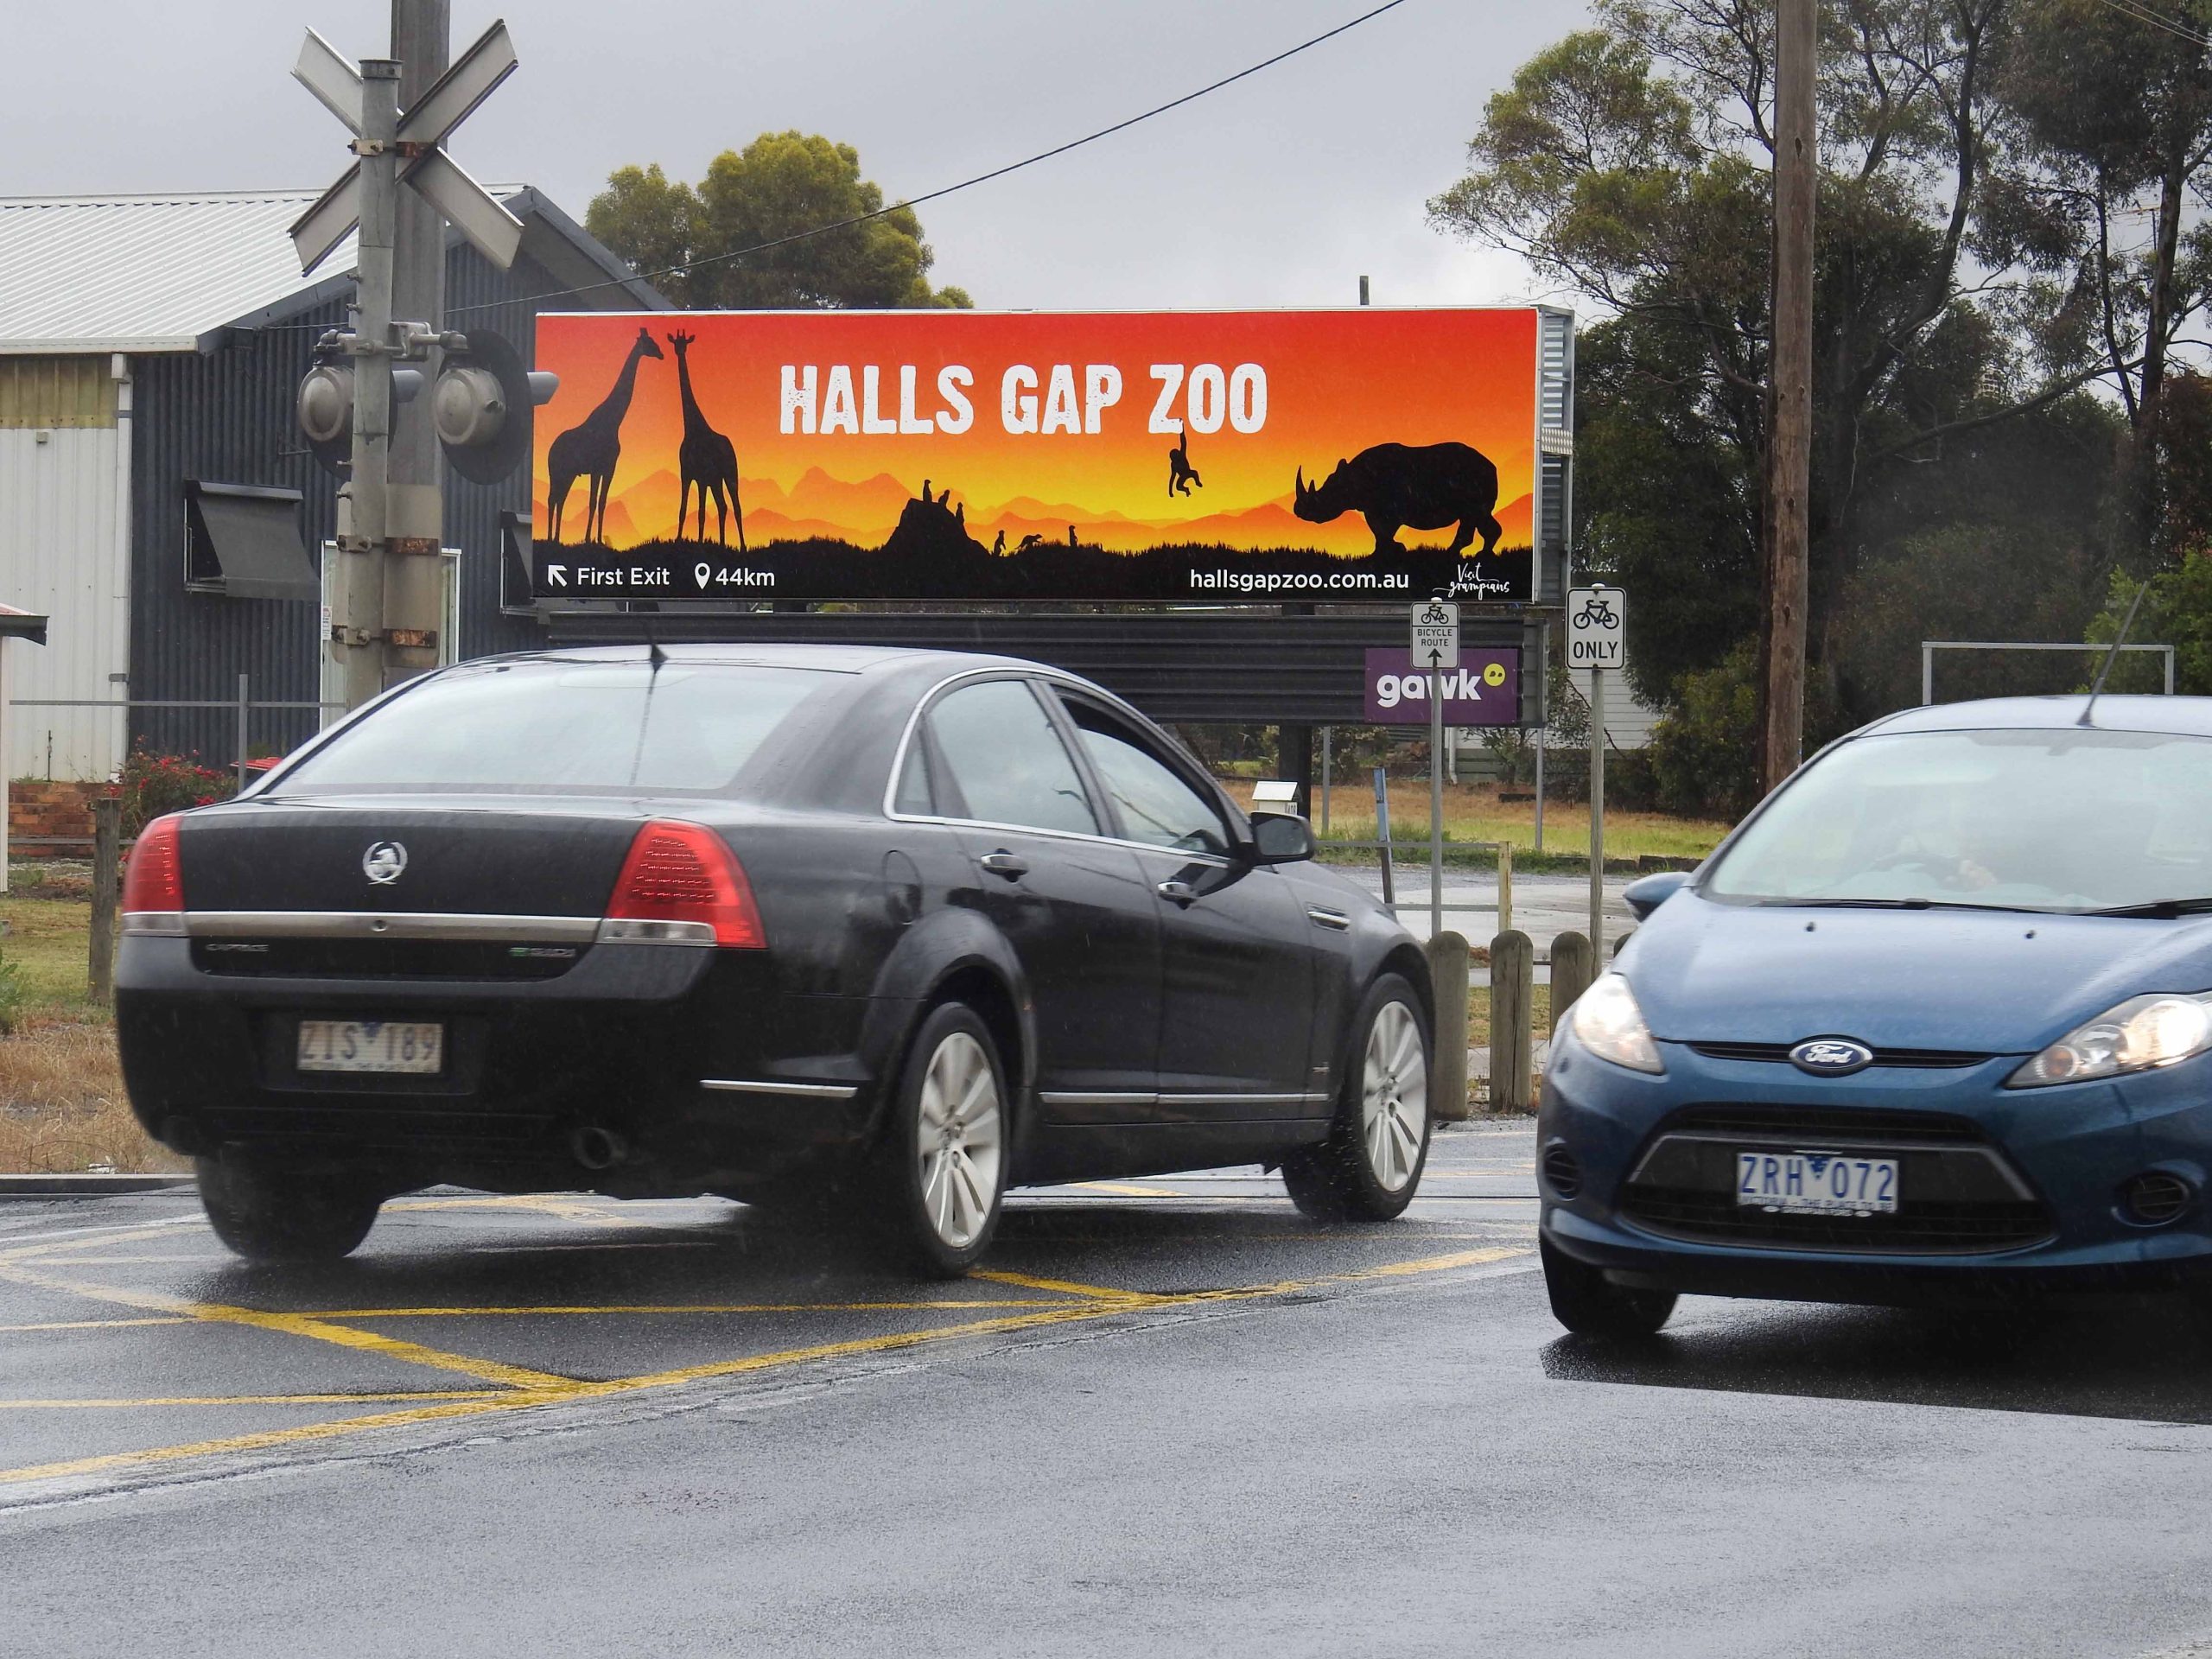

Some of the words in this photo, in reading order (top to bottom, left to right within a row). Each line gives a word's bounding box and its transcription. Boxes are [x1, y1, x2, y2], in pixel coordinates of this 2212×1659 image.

[780, 364, 975, 435] HALLS
[1001, 364, 1122, 435] GAP
[1147, 362, 1268, 435] ZOO
[576, 566, 624, 586] First
[630, 566, 671, 586] Exit
[715, 567, 775, 587] 44km
[1190, 569, 1409, 592] hallsgapzoo.com.au
[1457, 562, 1500, 583] Visit
[1432, 581, 1510, 601] grampians
[1417, 628, 1452, 637] BICYCLE
[1421, 639, 1449, 647] ROUTE
[1573, 640, 1618, 659] ONLY
[1376, 668, 1482, 709] gawk
[1804, 1044, 1854, 1064] Ford
[1741, 1155, 1803, 1196] ZRH
[1831, 1161, 1893, 1202] 072
